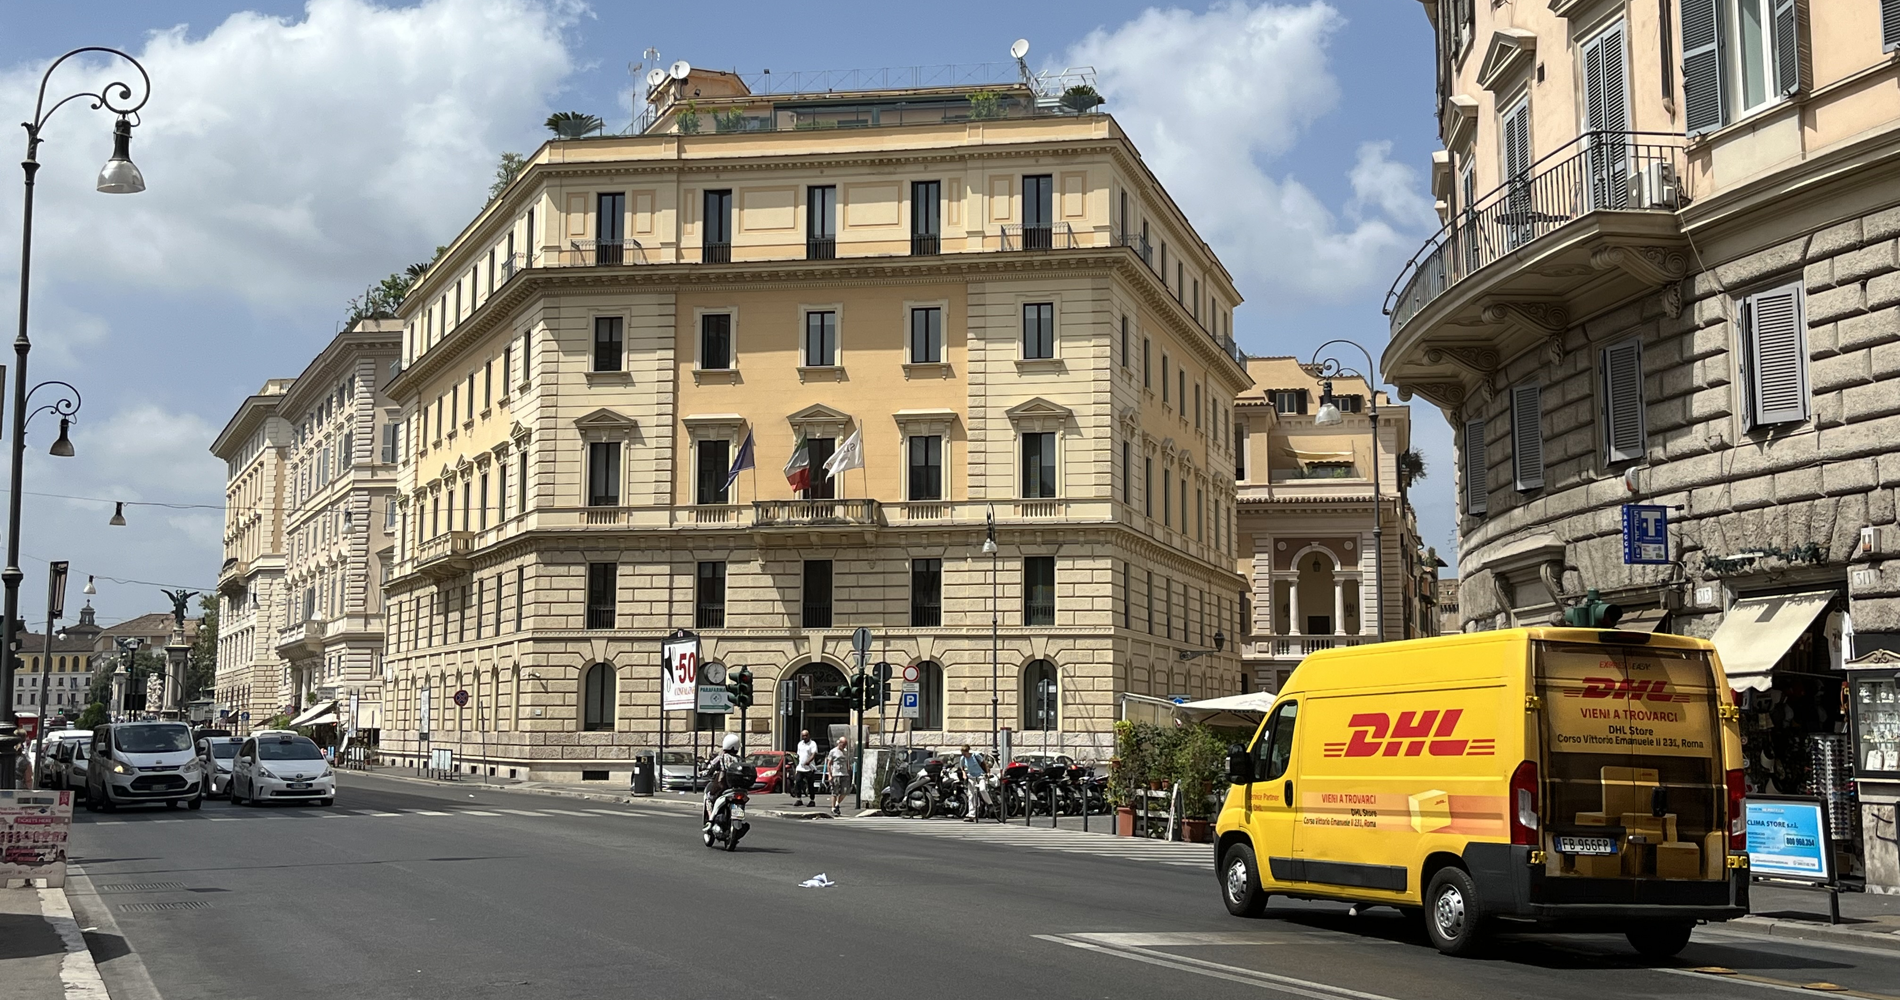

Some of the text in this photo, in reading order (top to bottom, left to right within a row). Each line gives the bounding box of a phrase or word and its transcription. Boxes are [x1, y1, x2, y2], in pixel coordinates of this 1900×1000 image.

[1855, 571, 1872, 586] 311
[1697, 588, 1711, 602] 313
[1581, 677, 1673, 702] DHL
[906, 695, 915, 706] P
[1580, 708, 1678, 722] VIENI A TROVARCI
[1344, 709, 1470, 757] DHL
[1608, 725, 1654, 736] DHL Store
[1557, 734, 1581, 744] Corso
[1583, 735, 1613, 745] Vittorio
[1615, 736, 1654, 746] Emanuele
[1681, 739, 1704, 749] Roma
[1321, 794, 1376, 804] VIENI A TROVARCI
[1303, 816, 1315, 825] Corso
[1746, 819, 1766, 827] CLIMA
[1766, 820, 1786, 828] STORE
[1562, 838, 1609, 851] FB 966FP
